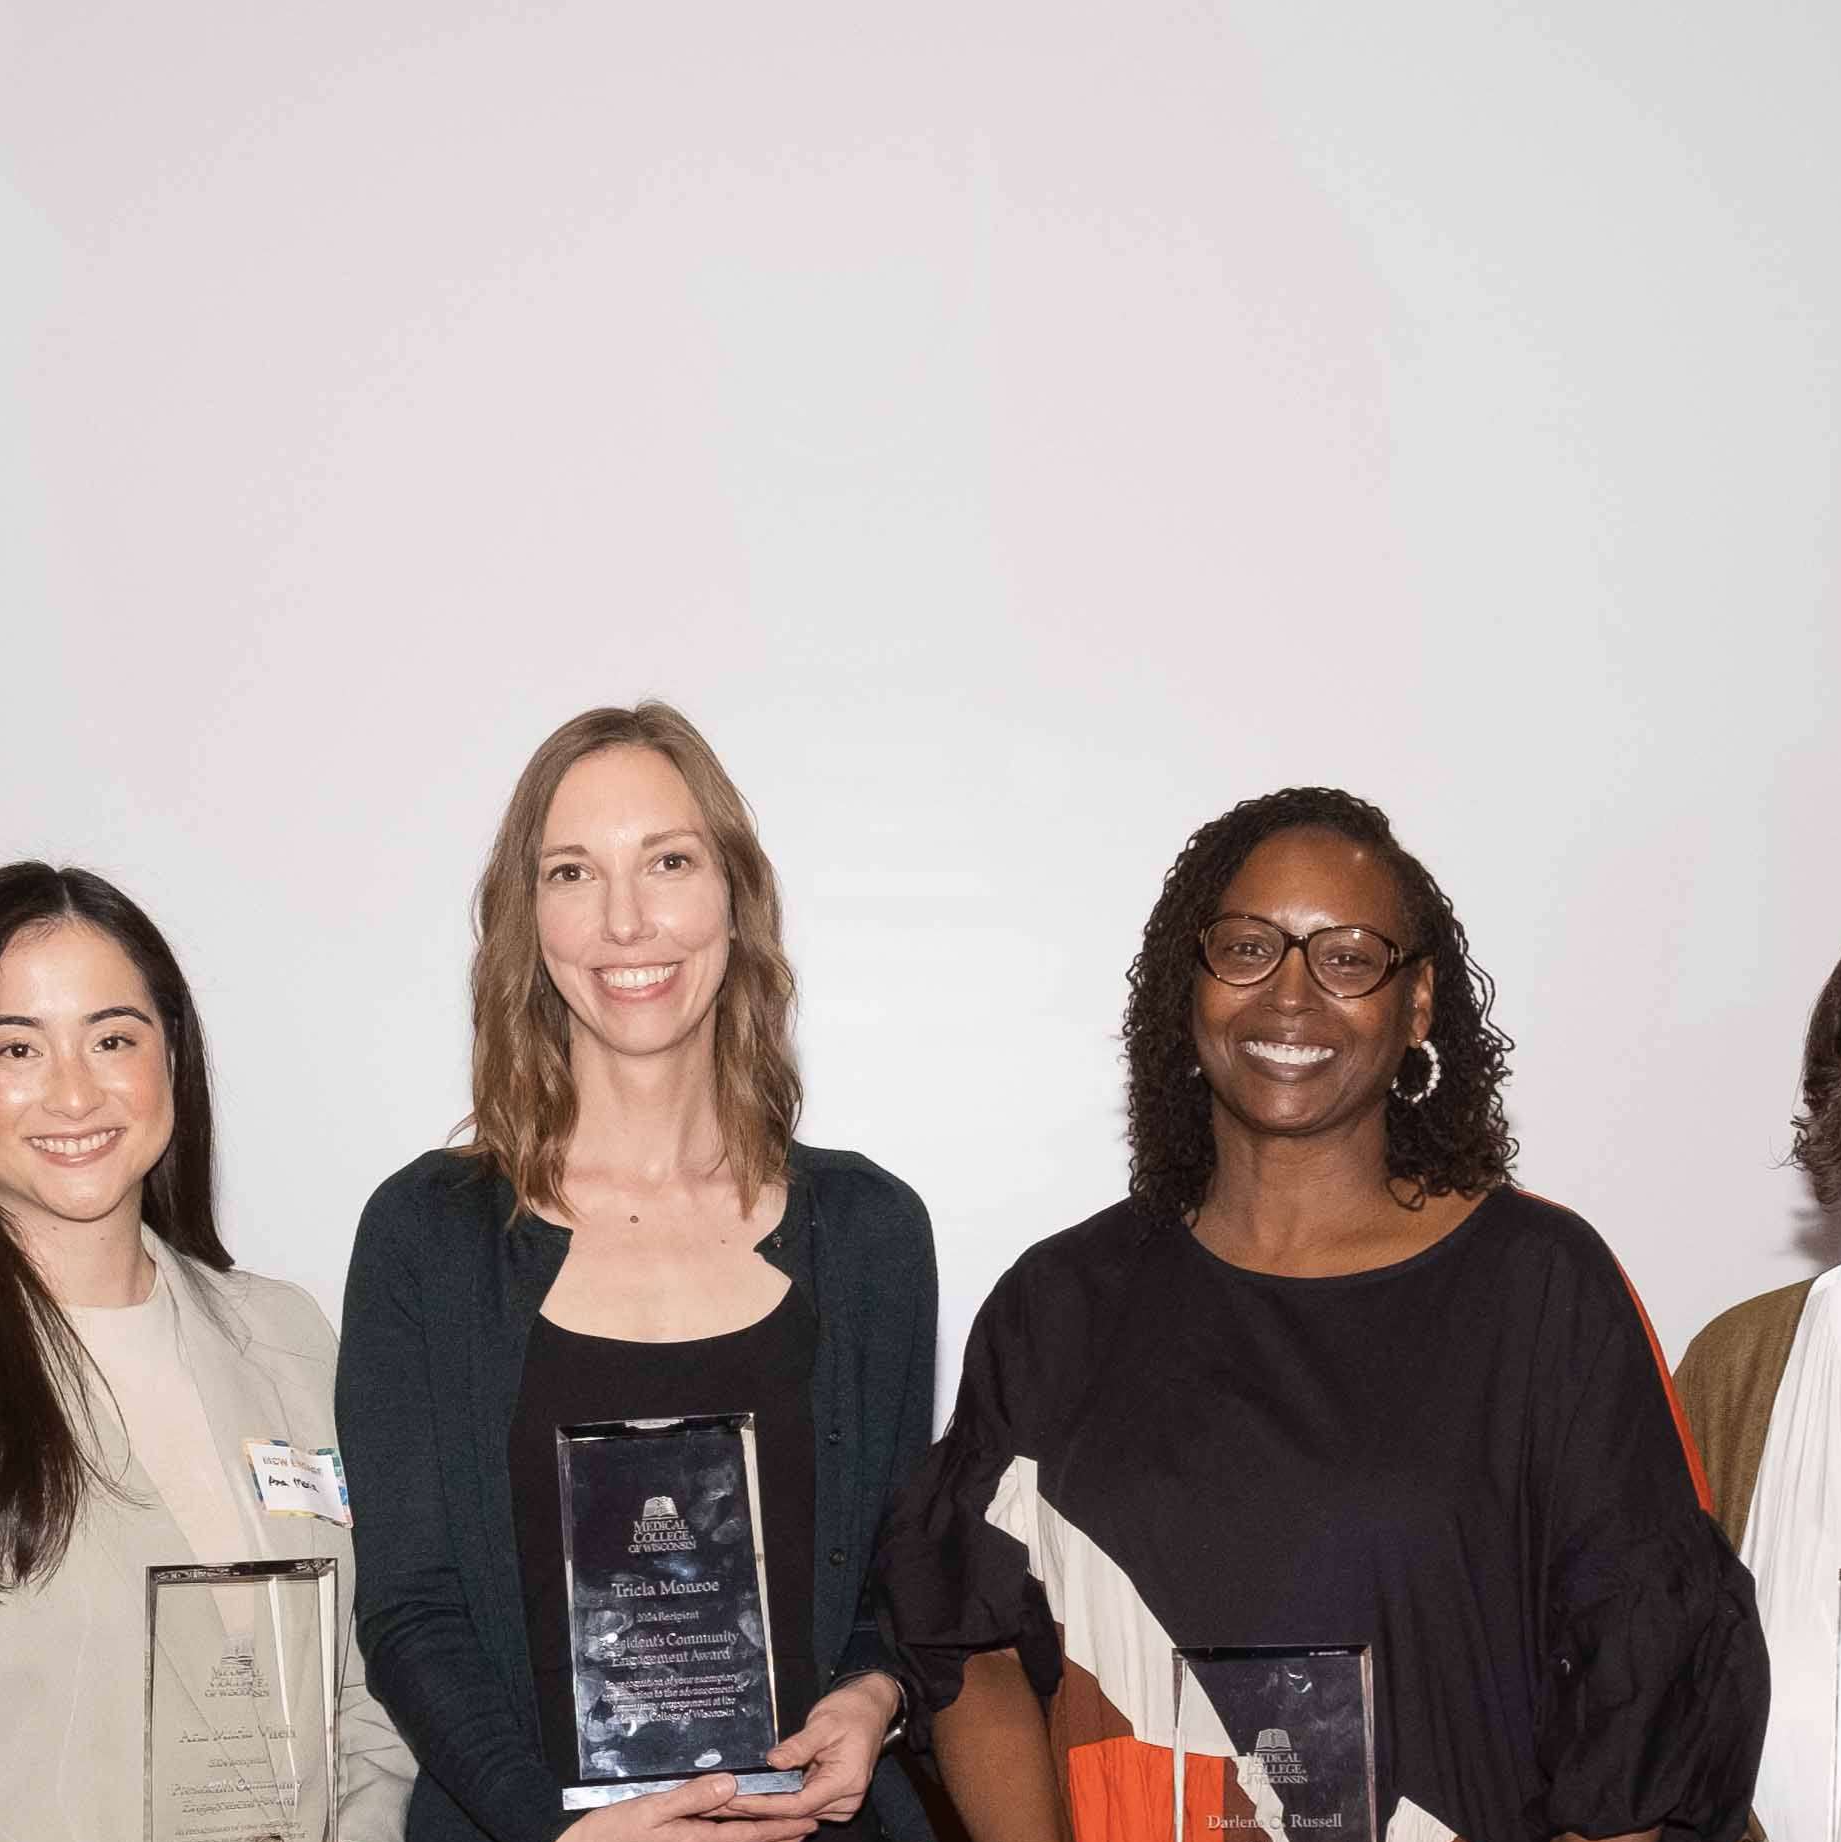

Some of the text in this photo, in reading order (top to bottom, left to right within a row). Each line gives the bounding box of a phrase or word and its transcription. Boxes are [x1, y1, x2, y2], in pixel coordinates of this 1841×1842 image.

[633, 1519, 688, 1533] MEDICAL
[628, 1539, 697, 1553] OF WISCONSIN
[658, 1579, 719, 1595] Monroe
[666, 1629, 739, 1647] Community
[612, 1645, 732, 1669] Engagement Award
[1290, 1813, 1342, 1828] Russell
